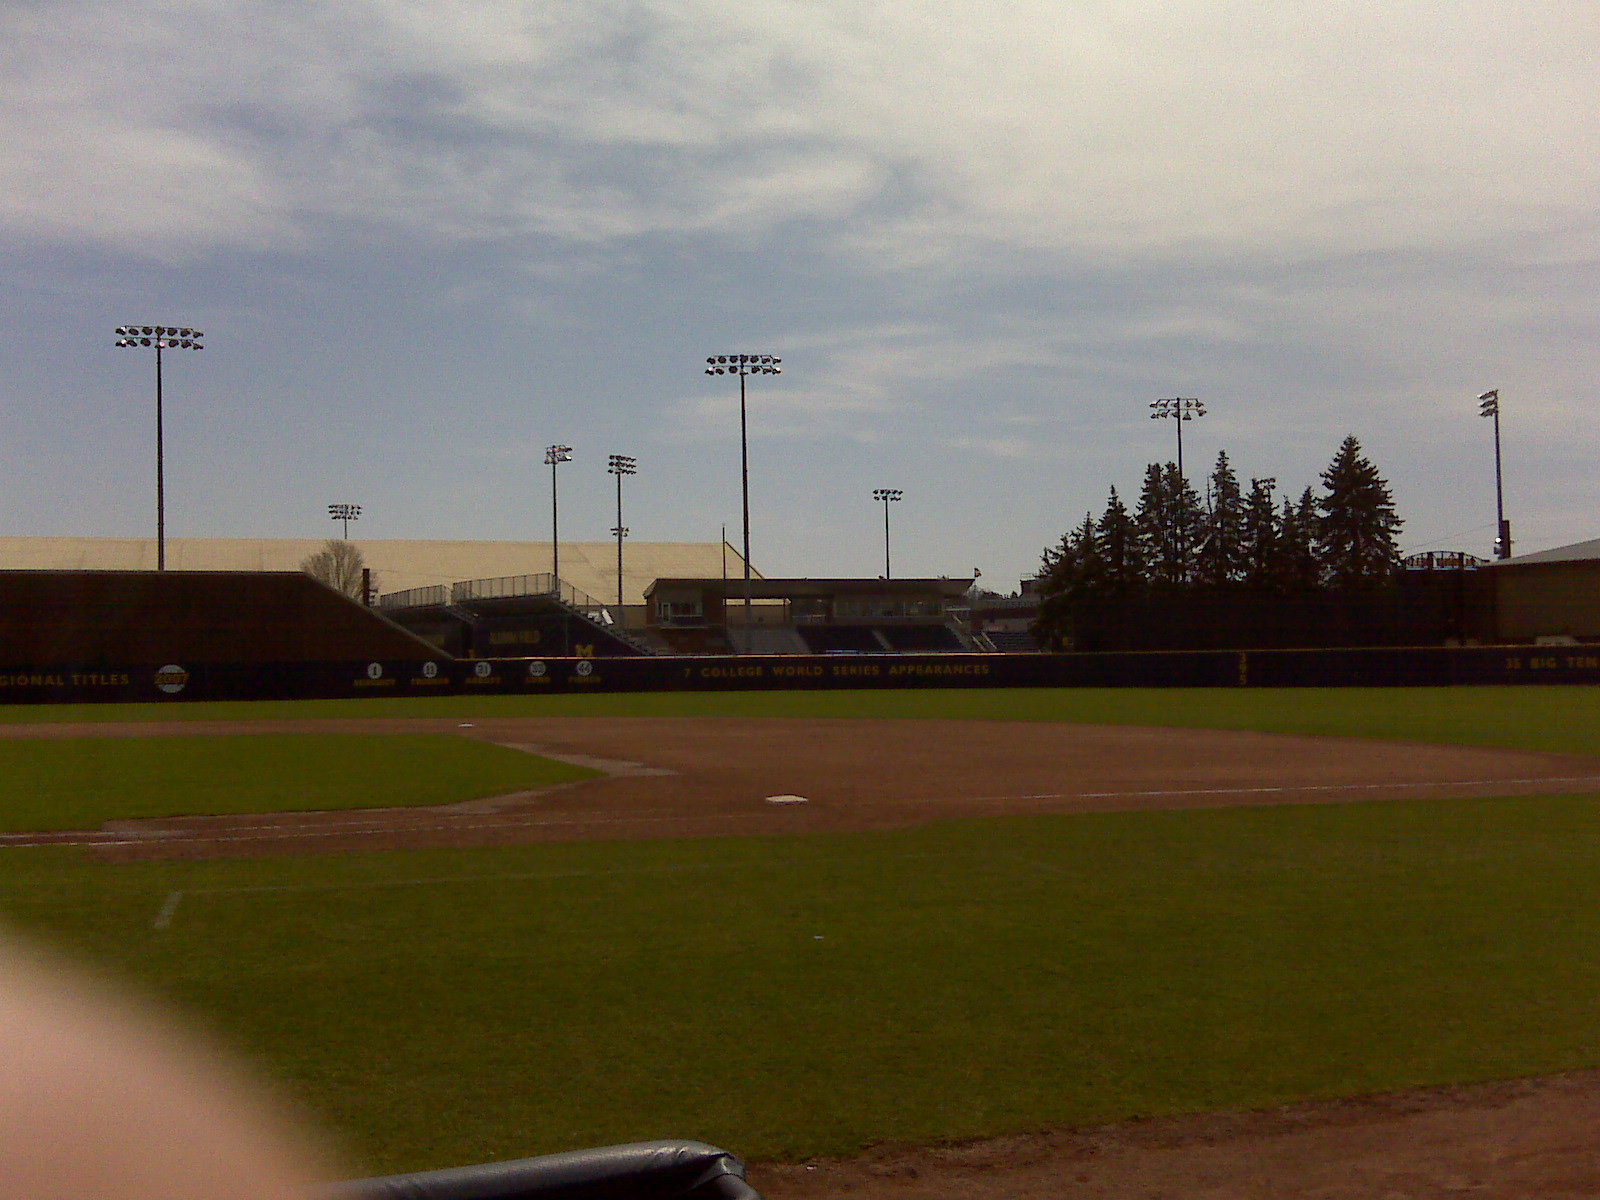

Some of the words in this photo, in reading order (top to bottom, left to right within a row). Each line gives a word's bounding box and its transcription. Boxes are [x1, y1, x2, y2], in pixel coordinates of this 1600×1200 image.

[575, 644, 594, 656] M
[1530, 656, 1557, 669] BIG
[1566, 656, 1599, 669] TEN
[684, 668, 692, 678] 7
[700, 666, 763, 678] COLLEGE
[772, 665, 824, 676] WORLD
[832, 664, 880, 676] SERIES
[889, 664, 991, 675] APPEARANCES
[71, 673, 130, 686] TITLES
